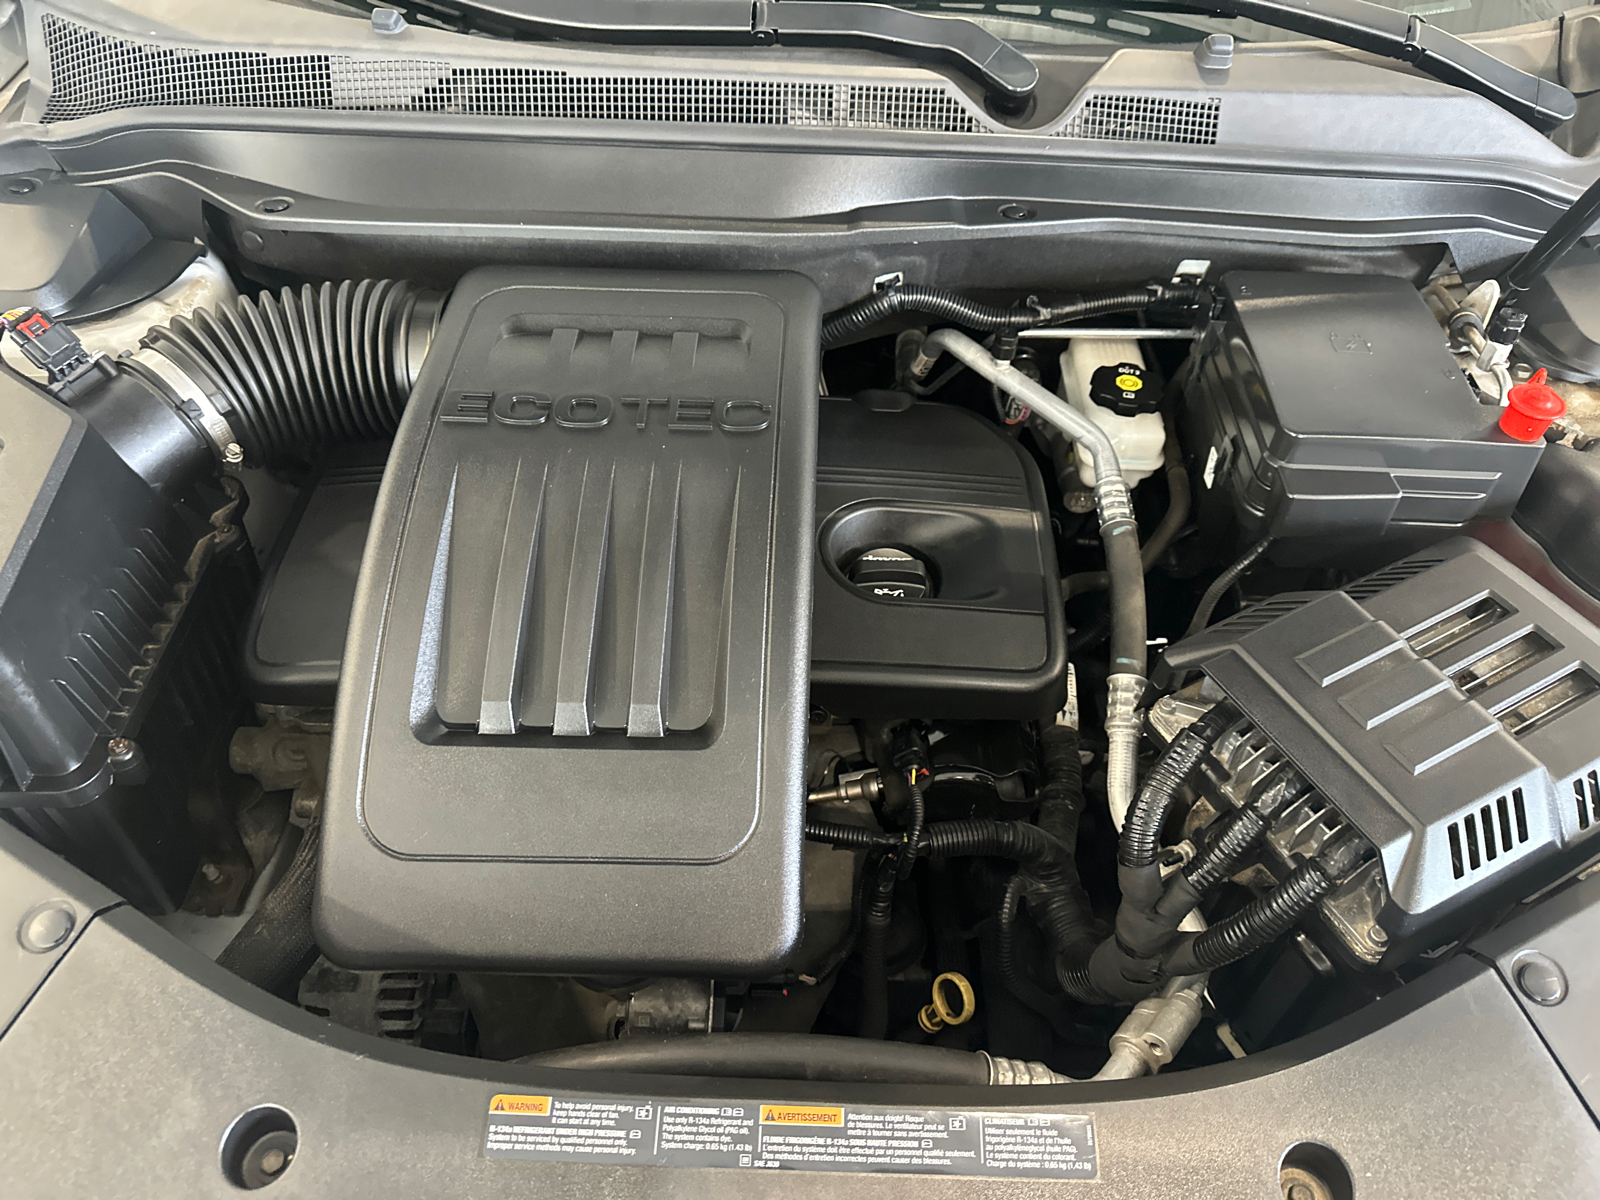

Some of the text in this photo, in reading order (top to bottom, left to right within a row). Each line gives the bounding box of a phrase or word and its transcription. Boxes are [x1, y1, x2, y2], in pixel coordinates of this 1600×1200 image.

[439, 391, 772, 432] ECOTEC
[508, 1103, 543, 1112] WARNING
[554, 1101, 561, 1109] To
[562, 1102, 575, 1110] help
[552, 1109, 567, 1117] keep
[676, 1107, 720, 1115] CONDITIONING
[675, 1117, 688, 1125] only
[711, 1118, 741, 1126] Refrigerant
[777, 1113, 838, 1122] AVERTISSEMENT
[847, 1113, 873, 1121] Attention
[905, 1115, 925, 1123] Risque
[590, 1119, 601, 1127] any
[893, 1122, 923, 1130] ventilateur
[513, 1126, 555, 1135] REFRIGERANT
[556, 1128, 578, 1136] UNDER
[594, 1130, 627, 1138] PRESSURE
[698, 1125, 716, 1134] Glycol
[725, 1126, 739, 1134] (PAG
[488, 1133, 511, 1142] System
[511, 1134, 518, 1142] to
[527, 1135, 551, 1143] serviced
[552, 1136, 560, 1144] by
[560, 1136, 585, 1144] qualified
[1016, 1136, 1038, 1144] R-134a
[487, 1141, 513, 1150] Improper
[514, 1143, 535, 1151] service
[562, 1145, 574, 1154] may
[593, 1146, 618, 1154] personal
[661, 1141, 683, 1149] System
[683, 1142, 705, 1151] charge:
[720, 1144, 728, 1152] kg
[745, 1144, 753, 1152] lb)
[867, 1139, 888, 1147] HAUTE
[888, 1140, 919, 1148] PRESSION
[802, 1145, 827, 1154] système
[1046, 1145, 1061, 1153] (huile
[762, 1152, 774, 1160] Des
[835, 1155, 867, 1163] incorrectes
[867, 1156, 891, 1164] peuvent
[911, 1157, 923, 1165] des
[986, 1151, 994, 1159] Le
[994, 1152, 1019, 1160] système
[986, 1160, 1008, 1169] Charge
[1008, 1160, 1017, 1168] du
[1017, 1160, 1041, 1169] système
[1059, 1162, 1067, 1170] kg
